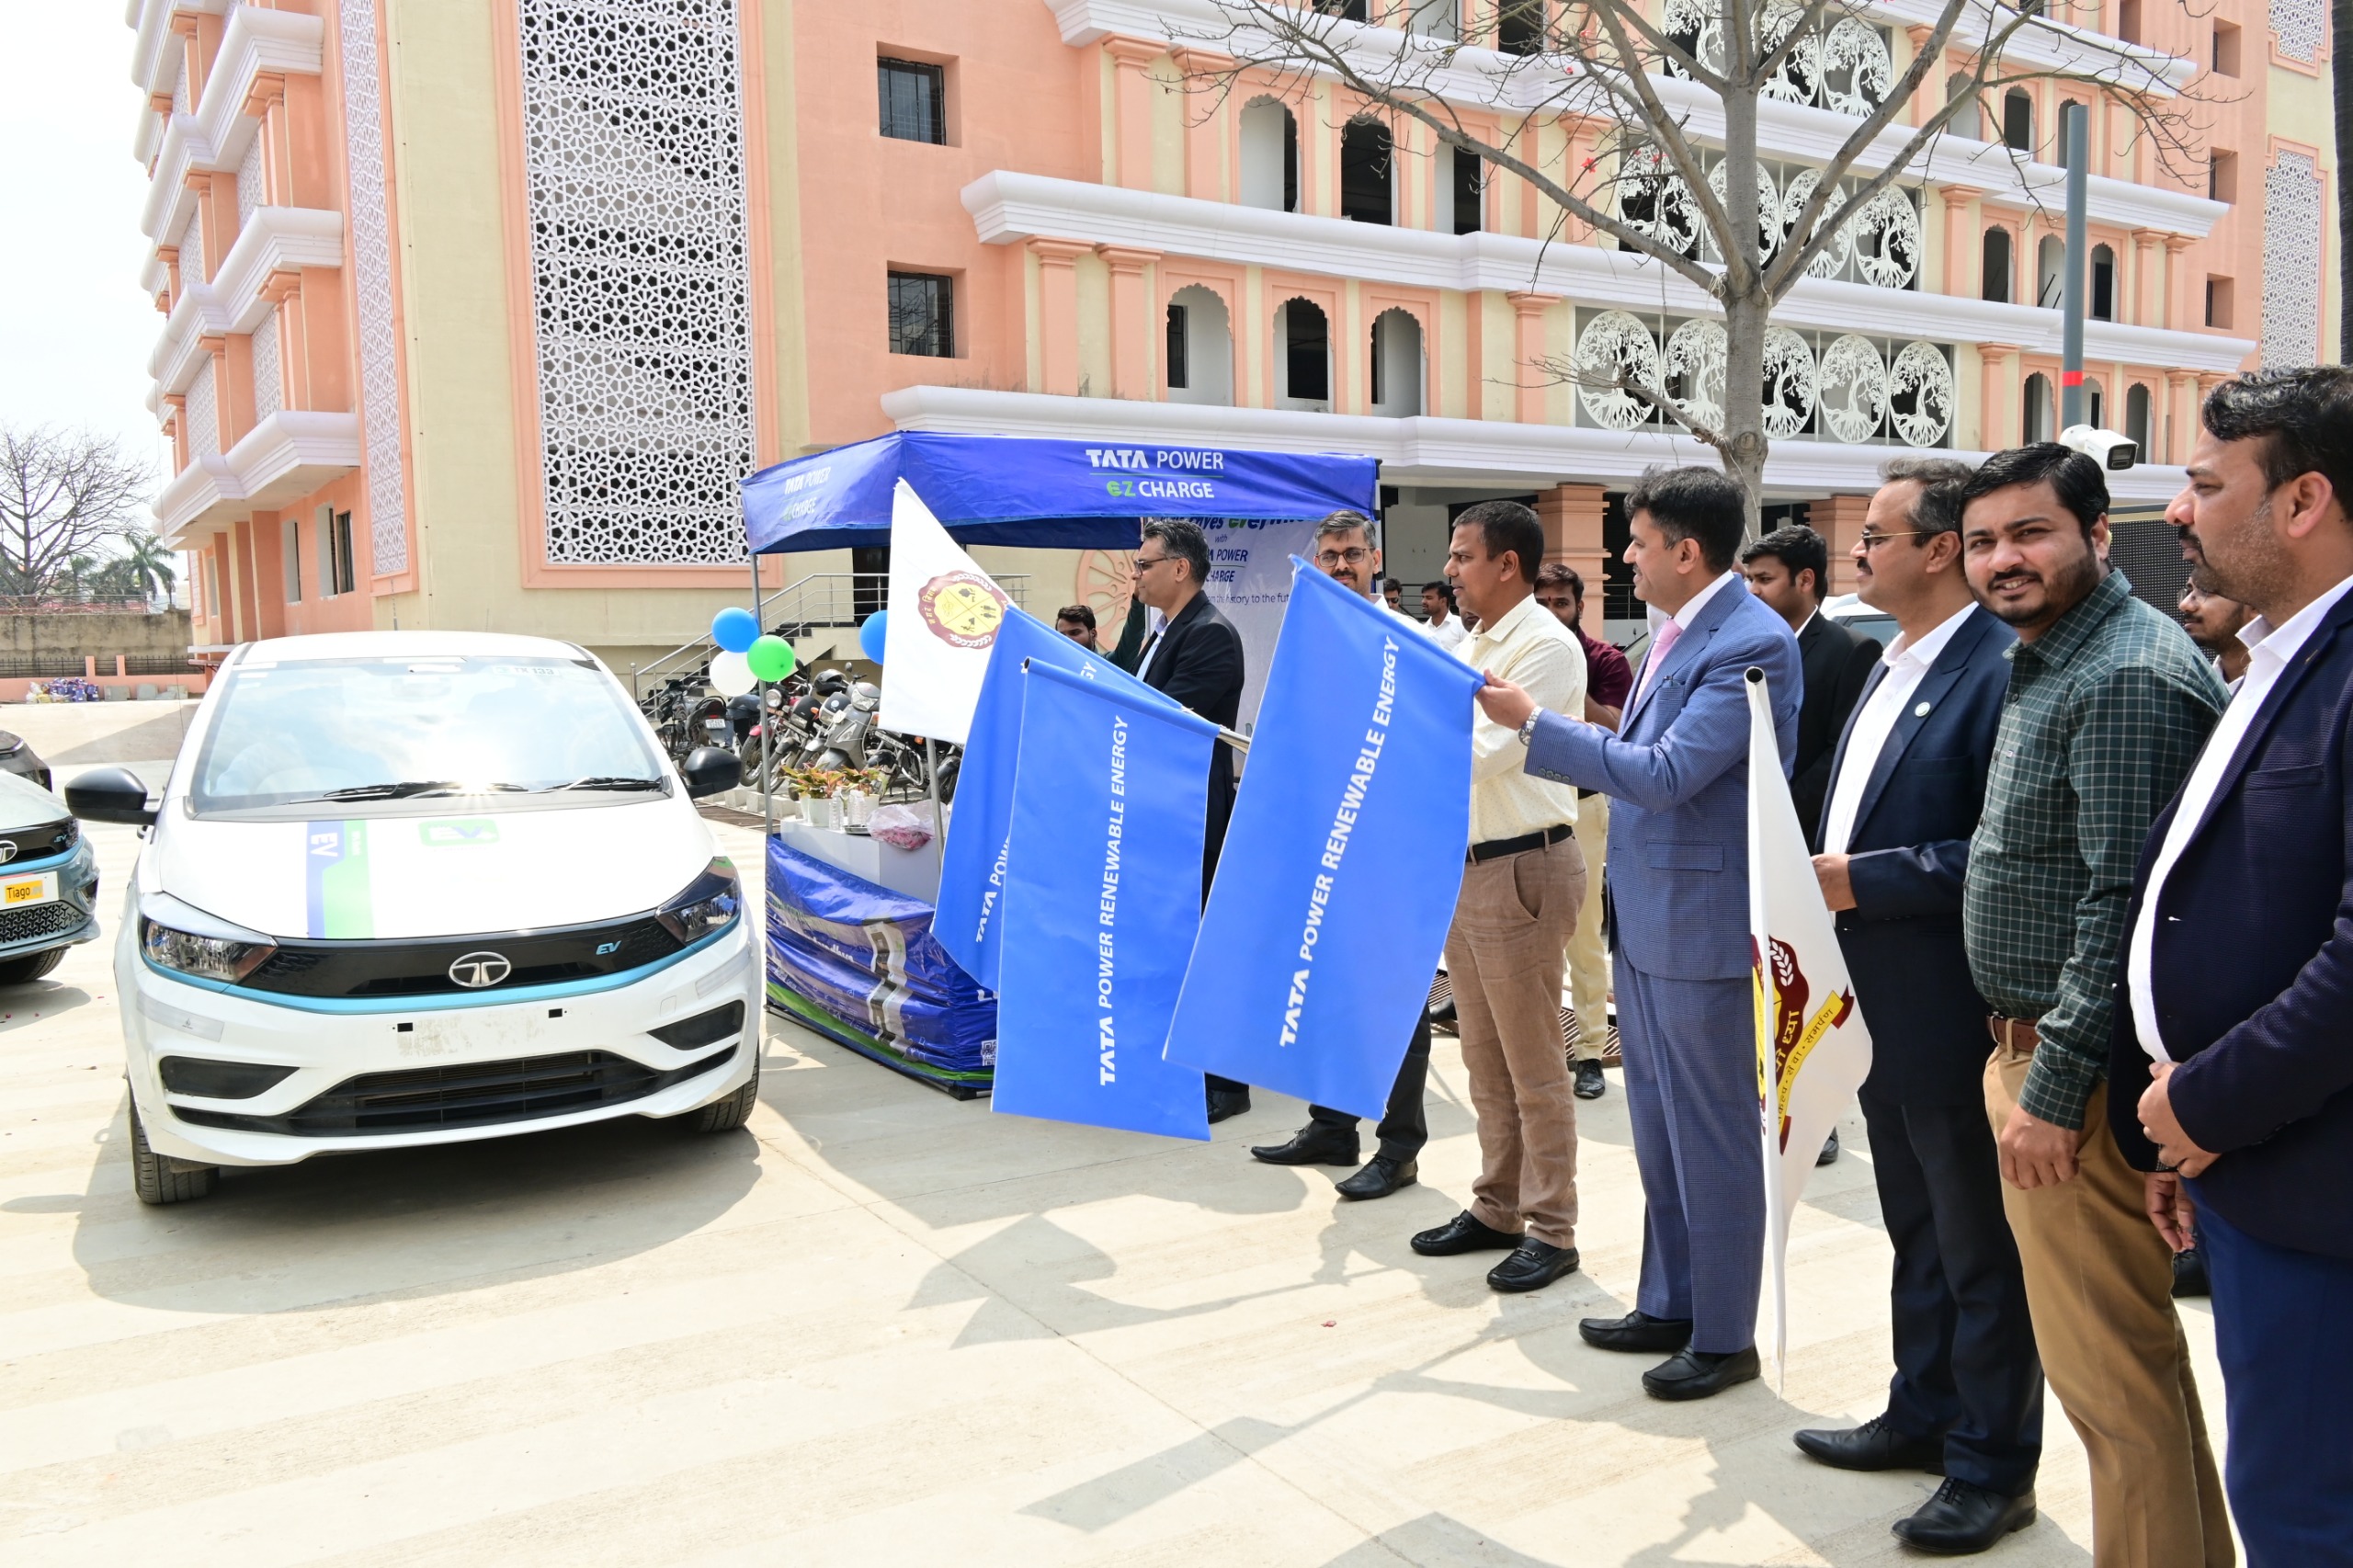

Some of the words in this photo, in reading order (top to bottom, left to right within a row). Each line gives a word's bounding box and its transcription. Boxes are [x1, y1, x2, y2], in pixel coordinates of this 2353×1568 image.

[1086, 449, 1150, 469] TATA
[1156, 450, 1224, 470] POWER
[784, 474, 804, 494] TATA
[804, 466, 831, 488] POWER
[1138, 481, 1215, 498] CHARGE
[791, 496, 817, 518] CHARGE
[1214, 534, 1228, 543] with
[1216, 549, 1248, 562] POWER
[1251, 595, 1260, 603] to
[1262, 594, 1276, 603] the
[1278, 592, 1289, 603] fut
[1110, 715, 1129, 797] ENERGY
[310, 832, 338, 857] EV
[1279, 969, 1310, 1048] TATA
[1299, 874, 1335, 961] POWER
[1321, 728, 1386, 871] RENEWABLE
[1372, 635, 1400, 727] ENERGY
[1099, 800, 1125, 926] RENEWABLE
[6, 886, 30, 899] Tiago
[975, 892, 997, 943] TATA
[989, 837, 1010, 887] POW
[596, 939, 622, 955] EV
[1098, 932, 1114, 1009] POWER
[1804, 1008, 1833, 1044] समर्पण
[1099, 1016, 1116, 1086] TATA
